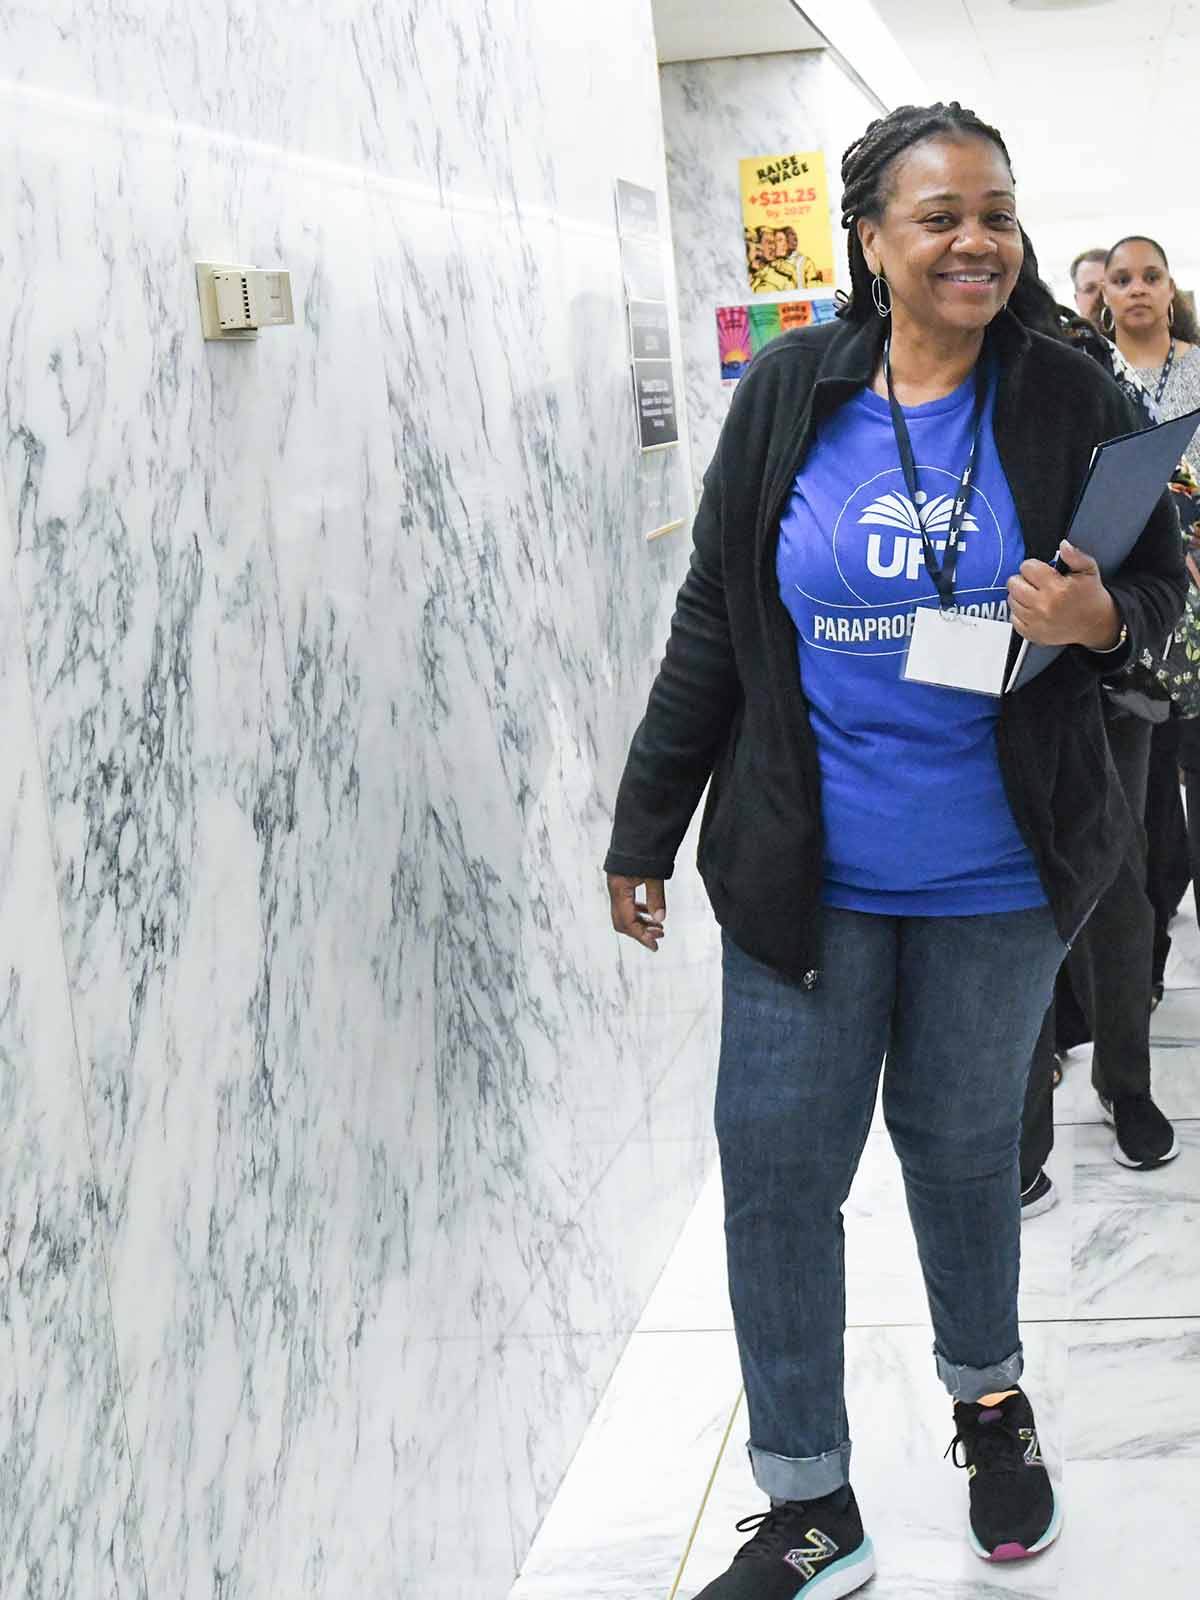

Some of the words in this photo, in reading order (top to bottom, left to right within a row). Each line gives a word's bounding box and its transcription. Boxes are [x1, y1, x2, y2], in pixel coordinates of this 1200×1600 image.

[757, 155, 798, 179] RAISE
[768, 162, 809, 185] WAGE
[814, 600, 1008, 642] PARAPROFONA
